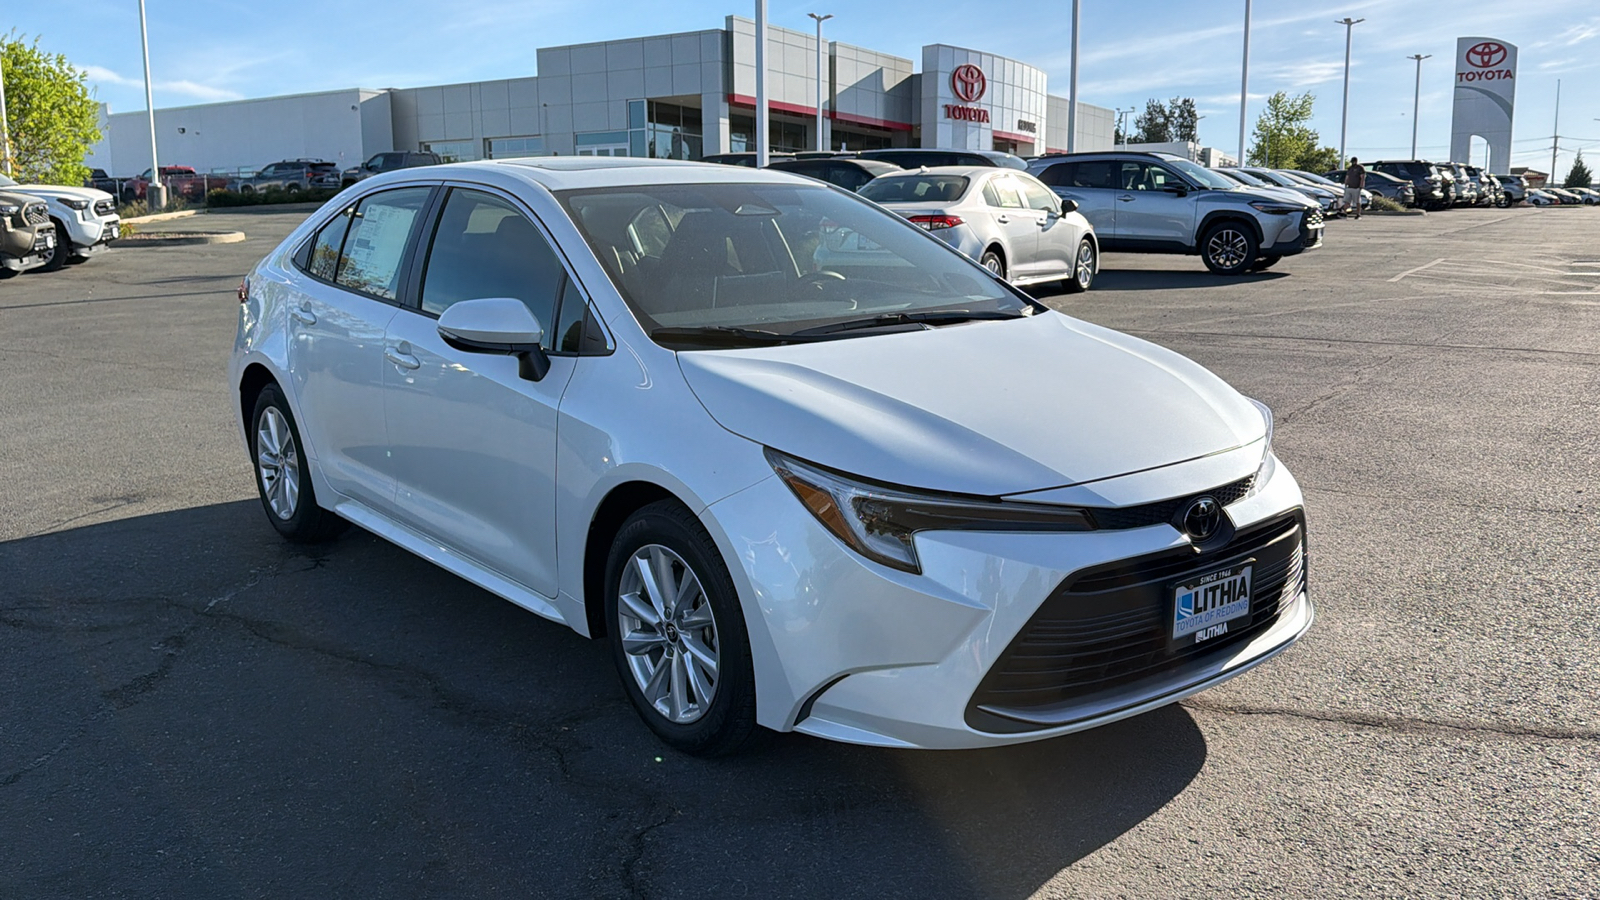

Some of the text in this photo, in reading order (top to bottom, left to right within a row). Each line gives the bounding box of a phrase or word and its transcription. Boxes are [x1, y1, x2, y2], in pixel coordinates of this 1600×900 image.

[1457, 69, 1513, 82] TOYOTA
[945, 104, 990, 123] TOYOTA
[1200, 573, 1218, 584] SINCE
[1193, 576, 1248, 615] LITHIA
[1176, 600, 1248, 632] TOYOTA OF REDDING
[1202, 622, 1228, 640] LITHIA
